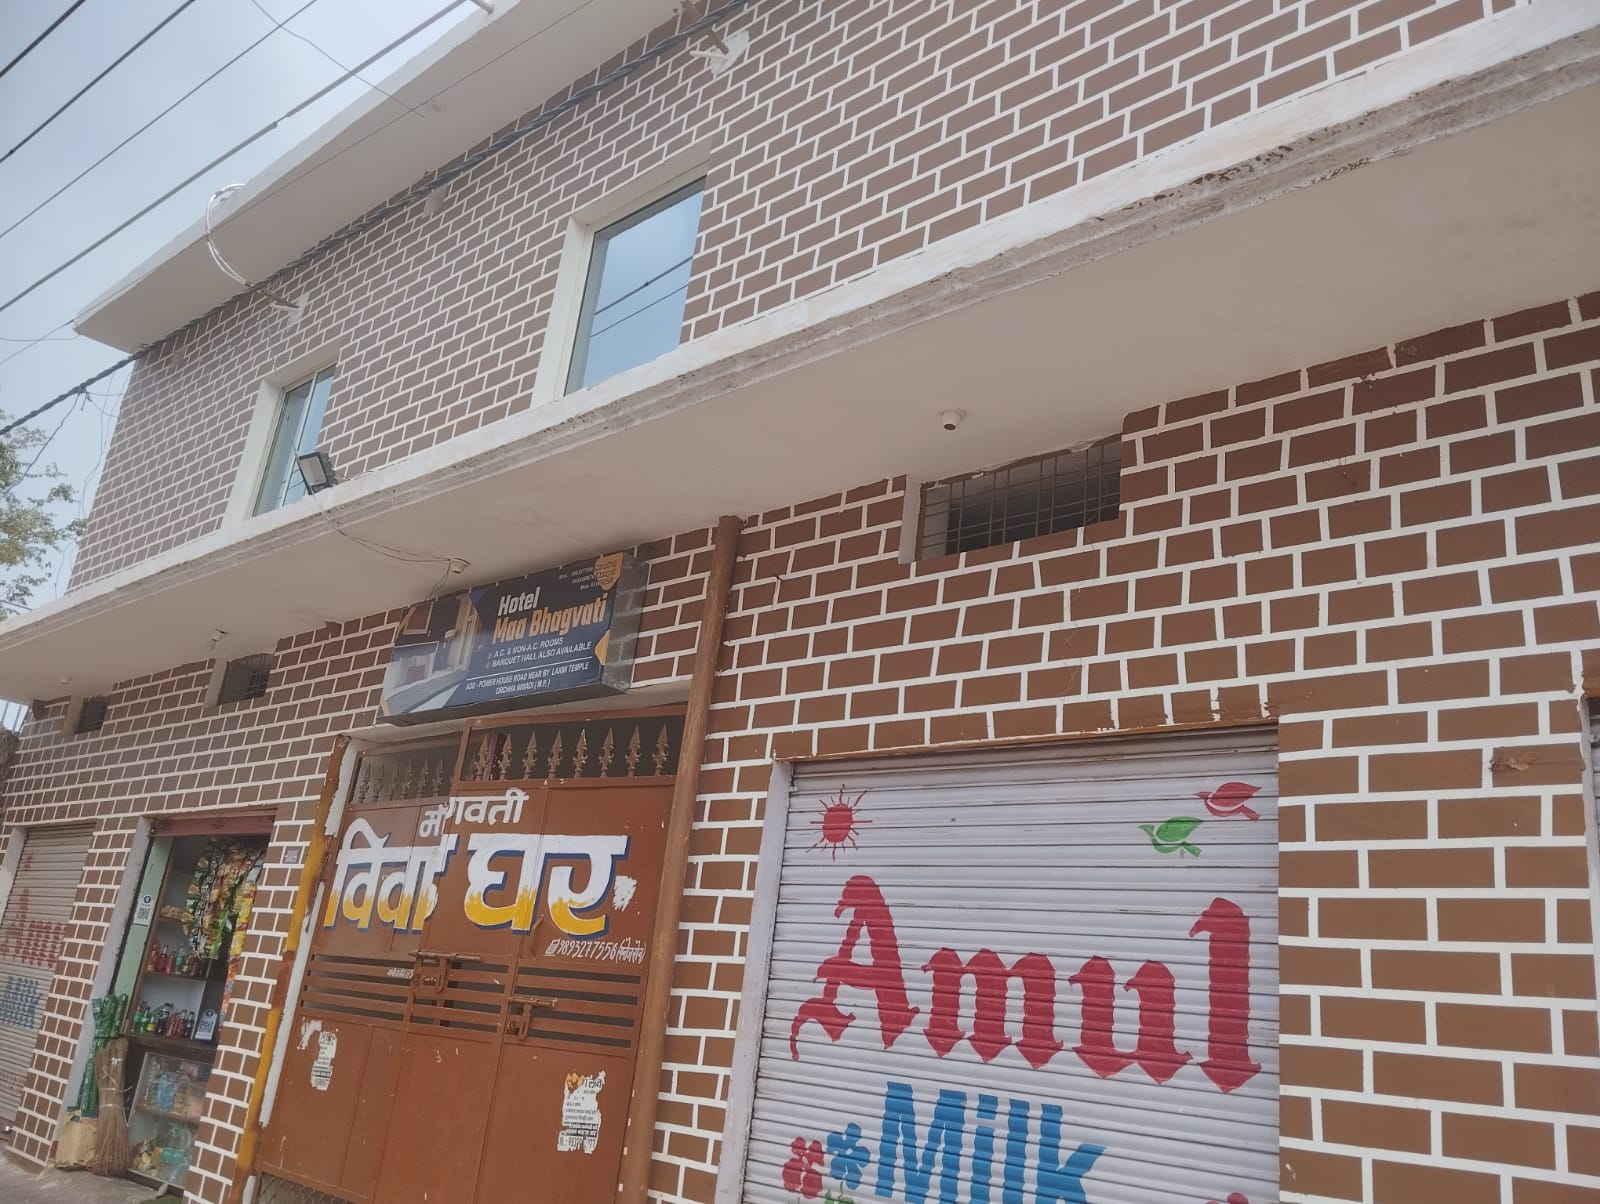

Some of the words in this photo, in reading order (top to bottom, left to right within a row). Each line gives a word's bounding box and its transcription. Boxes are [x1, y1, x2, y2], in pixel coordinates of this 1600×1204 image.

[498, 586, 541, 616] Hotel
[492, 616, 527, 645] Maa
[528, 592, 608, 636] Bhagvati
[491, 655, 520, 668] BANQUET
[521, 651, 537, 662] HALL
[537, 648, 556, 660] ALSO
[555, 641, 592, 656] AVAILABLE
[540, 637, 563, 649] ROOMS
[542, 668, 550, 678] BY
[568, 661, 590, 673] TEMPLE
[556, 938, 618, 961] 9893277556
[789, 874, 1262, 1094] Amul
[874, 1080, 1107, 1204] Milk
